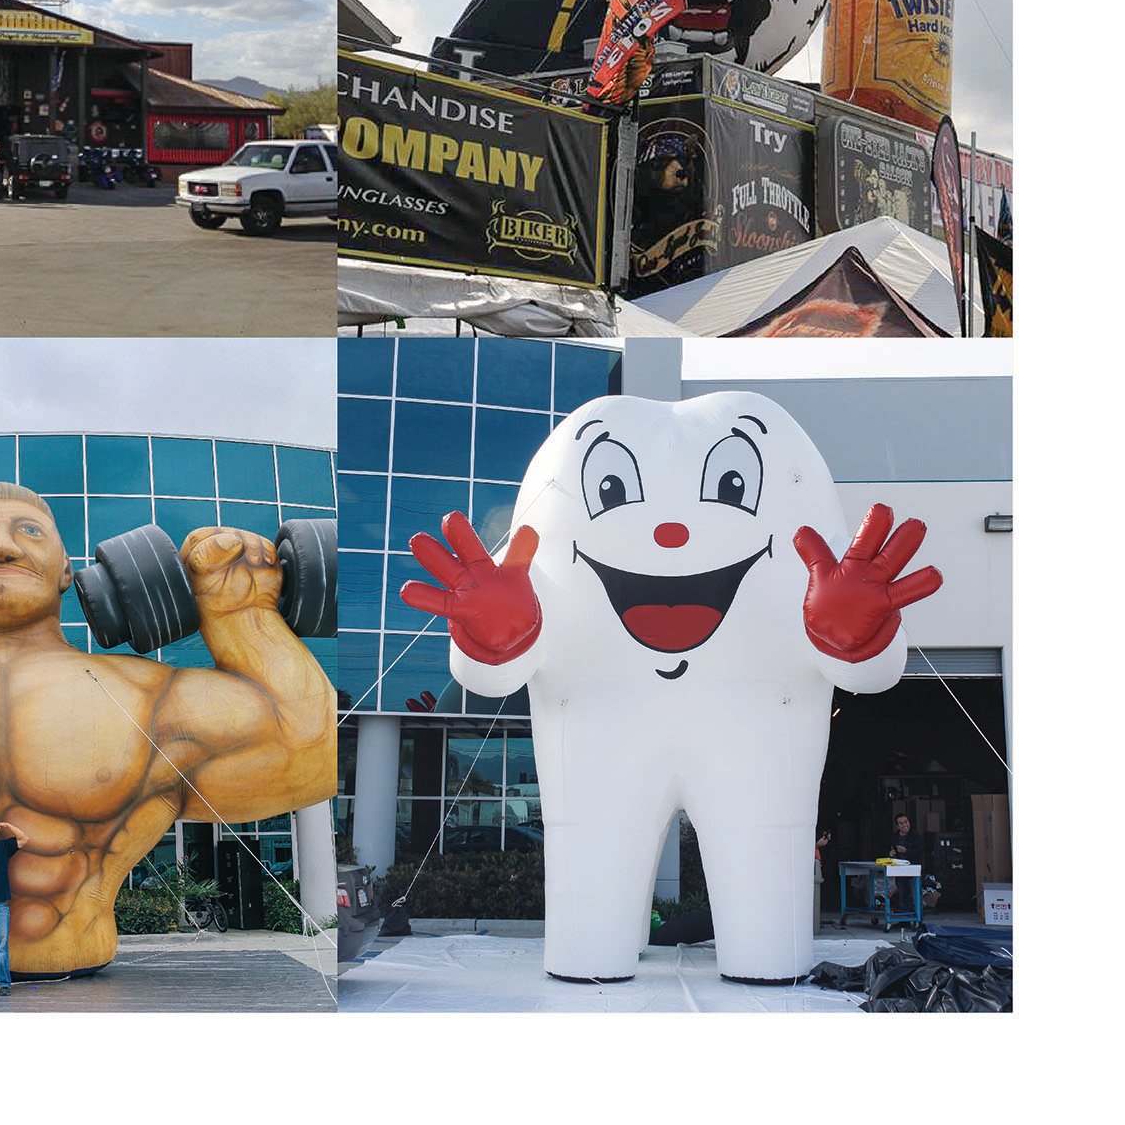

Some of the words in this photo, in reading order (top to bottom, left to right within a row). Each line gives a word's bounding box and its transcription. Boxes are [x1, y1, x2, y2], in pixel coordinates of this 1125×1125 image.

[908, 19, 938, 33] Hard
[749, 119, 787, 153] Try
[338, 115, 544, 192] OMPANY
[732, 180, 757, 215] FULL
[761, 177, 810, 234] THROTTLE
[338, 218, 425, 243] ny.com
[502, 216, 568, 248] BIKER
